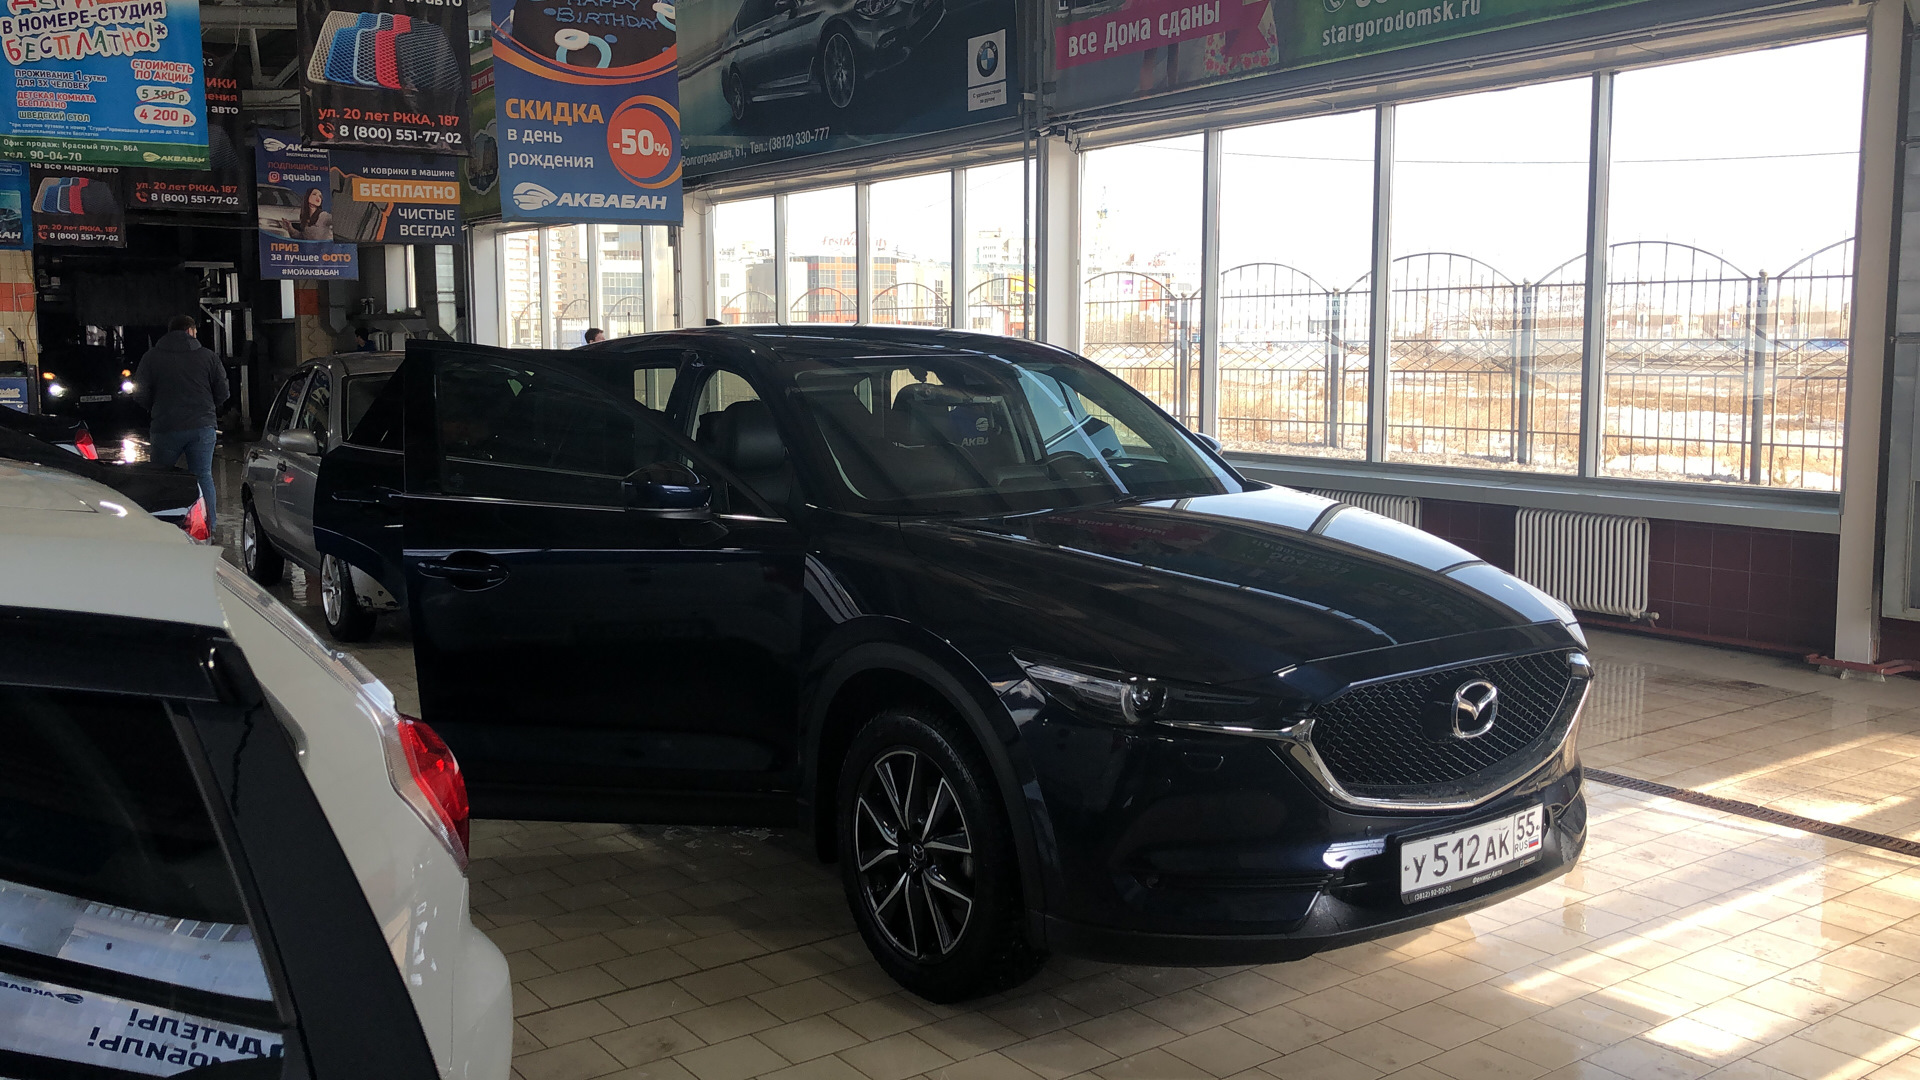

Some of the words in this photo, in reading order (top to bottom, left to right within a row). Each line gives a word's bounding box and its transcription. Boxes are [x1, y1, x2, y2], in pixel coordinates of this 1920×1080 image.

[2, 20, 13, 34] В
[18, 2, 163, 32] НОМЕРЕ-СТУДИЯ
[556, 8, 658, 30] BIRTHDAY
[1322, 0, 1481, 46] stargorodomsk.ru
[1068, 31, 1097, 57] все
[1104, 18, 1151, 53] Дома
[1158, 0, 1220, 38] сданы
[132, 60, 194, 74] СТОИМОСТЬ
[15, 70, 74, 80] ПРОЖИВАНИЕ
[136, 70, 151, 79] ПО
[154, 71, 192, 83] АКЦИИ:
[51, 81, 89, 90] ЧЕЛОВЕК
[17, 92, 55, 100] ДЕТСКАЯ
[57, 93, 96, 102] КОМНАТА
[142, 88, 149, 98] 5
[18, 100, 67, 108] БЕСПЛАТНО
[211, 106, 239, 114] авто
[19, 111, 65, 120] ШВЕДСКИЙ
[139, 108, 148, 120] 4
[153, 109, 179, 121] 200
[182, 114, 194, 124] р.
[318, 108, 340, 120] ул.
[344, 108, 361, 120] 20
[365, 112, 390, 122] лет
[394, 112, 435, 126] РККА,
[438, 115, 460, 126] 187
[505, 98, 604, 126] СКИДКА
[340, 125, 350, 136] 8
[354, 125, 392, 142] (800)
[396, 130, 462, 144] 551-77-02
[507, 129, 518, 141] в
[522, 130, 563, 144] день
[3, 138, 24, 147] Офис
[26, 140, 60, 150] продаж:
[62, 141, 98, 150] Красный
[612, 128, 670, 157] -50%
[735, 145, 747, 158] 61,
[750, 141, 768, 154] Тел.:
[769, 133, 794, 152] (3812)
[796, 126, 830, 146] 330-777
[4, 150, 26, 159] тел.
[30, 150, 82, 161] 90-04-70
[508, 152, 594, 169] рождения
[64, 164, 95, 173] марки
[370, 166, 409, 176] коврики
[420, 168, 455, 178] машине
[282, 173, 322, 182] aquaban
[136, 182, 151, 190] ул.
[154, 182, 167, 190] 20
[169, 184, 186, 192] лет
[188, 184, 218, 194] РККА,
[221, 186, 238, 194] 187
[360, 183, 456, 200] БЕСПЛАТНО
[151, 193, 158, 201] 8
[160, 192, 188, 204] (800)
[191, 195, 238, 205] 551-77-02
[556, 192, 667, 210] АКВАБАН
[398, 208, 455, 221] ЧИСТЫЕ
[38, 224, 50, 232] ул.
[400, 225, 455, 238] ВСЕГДА!
[58, 232, 80, 241] (800)
[81, 234, 119, 242] 551-77-02
[270, 242, 300, 252] ПРИЗ
[284, 254, 319, 264] лучшее
[322, 253, 352, 262] ФОТО
[282, 267, 340, 276] #МОЙАКВАБАН
[1516, 812, 1536, 840] 55
[1515, 841, 1528, 853] RUS
